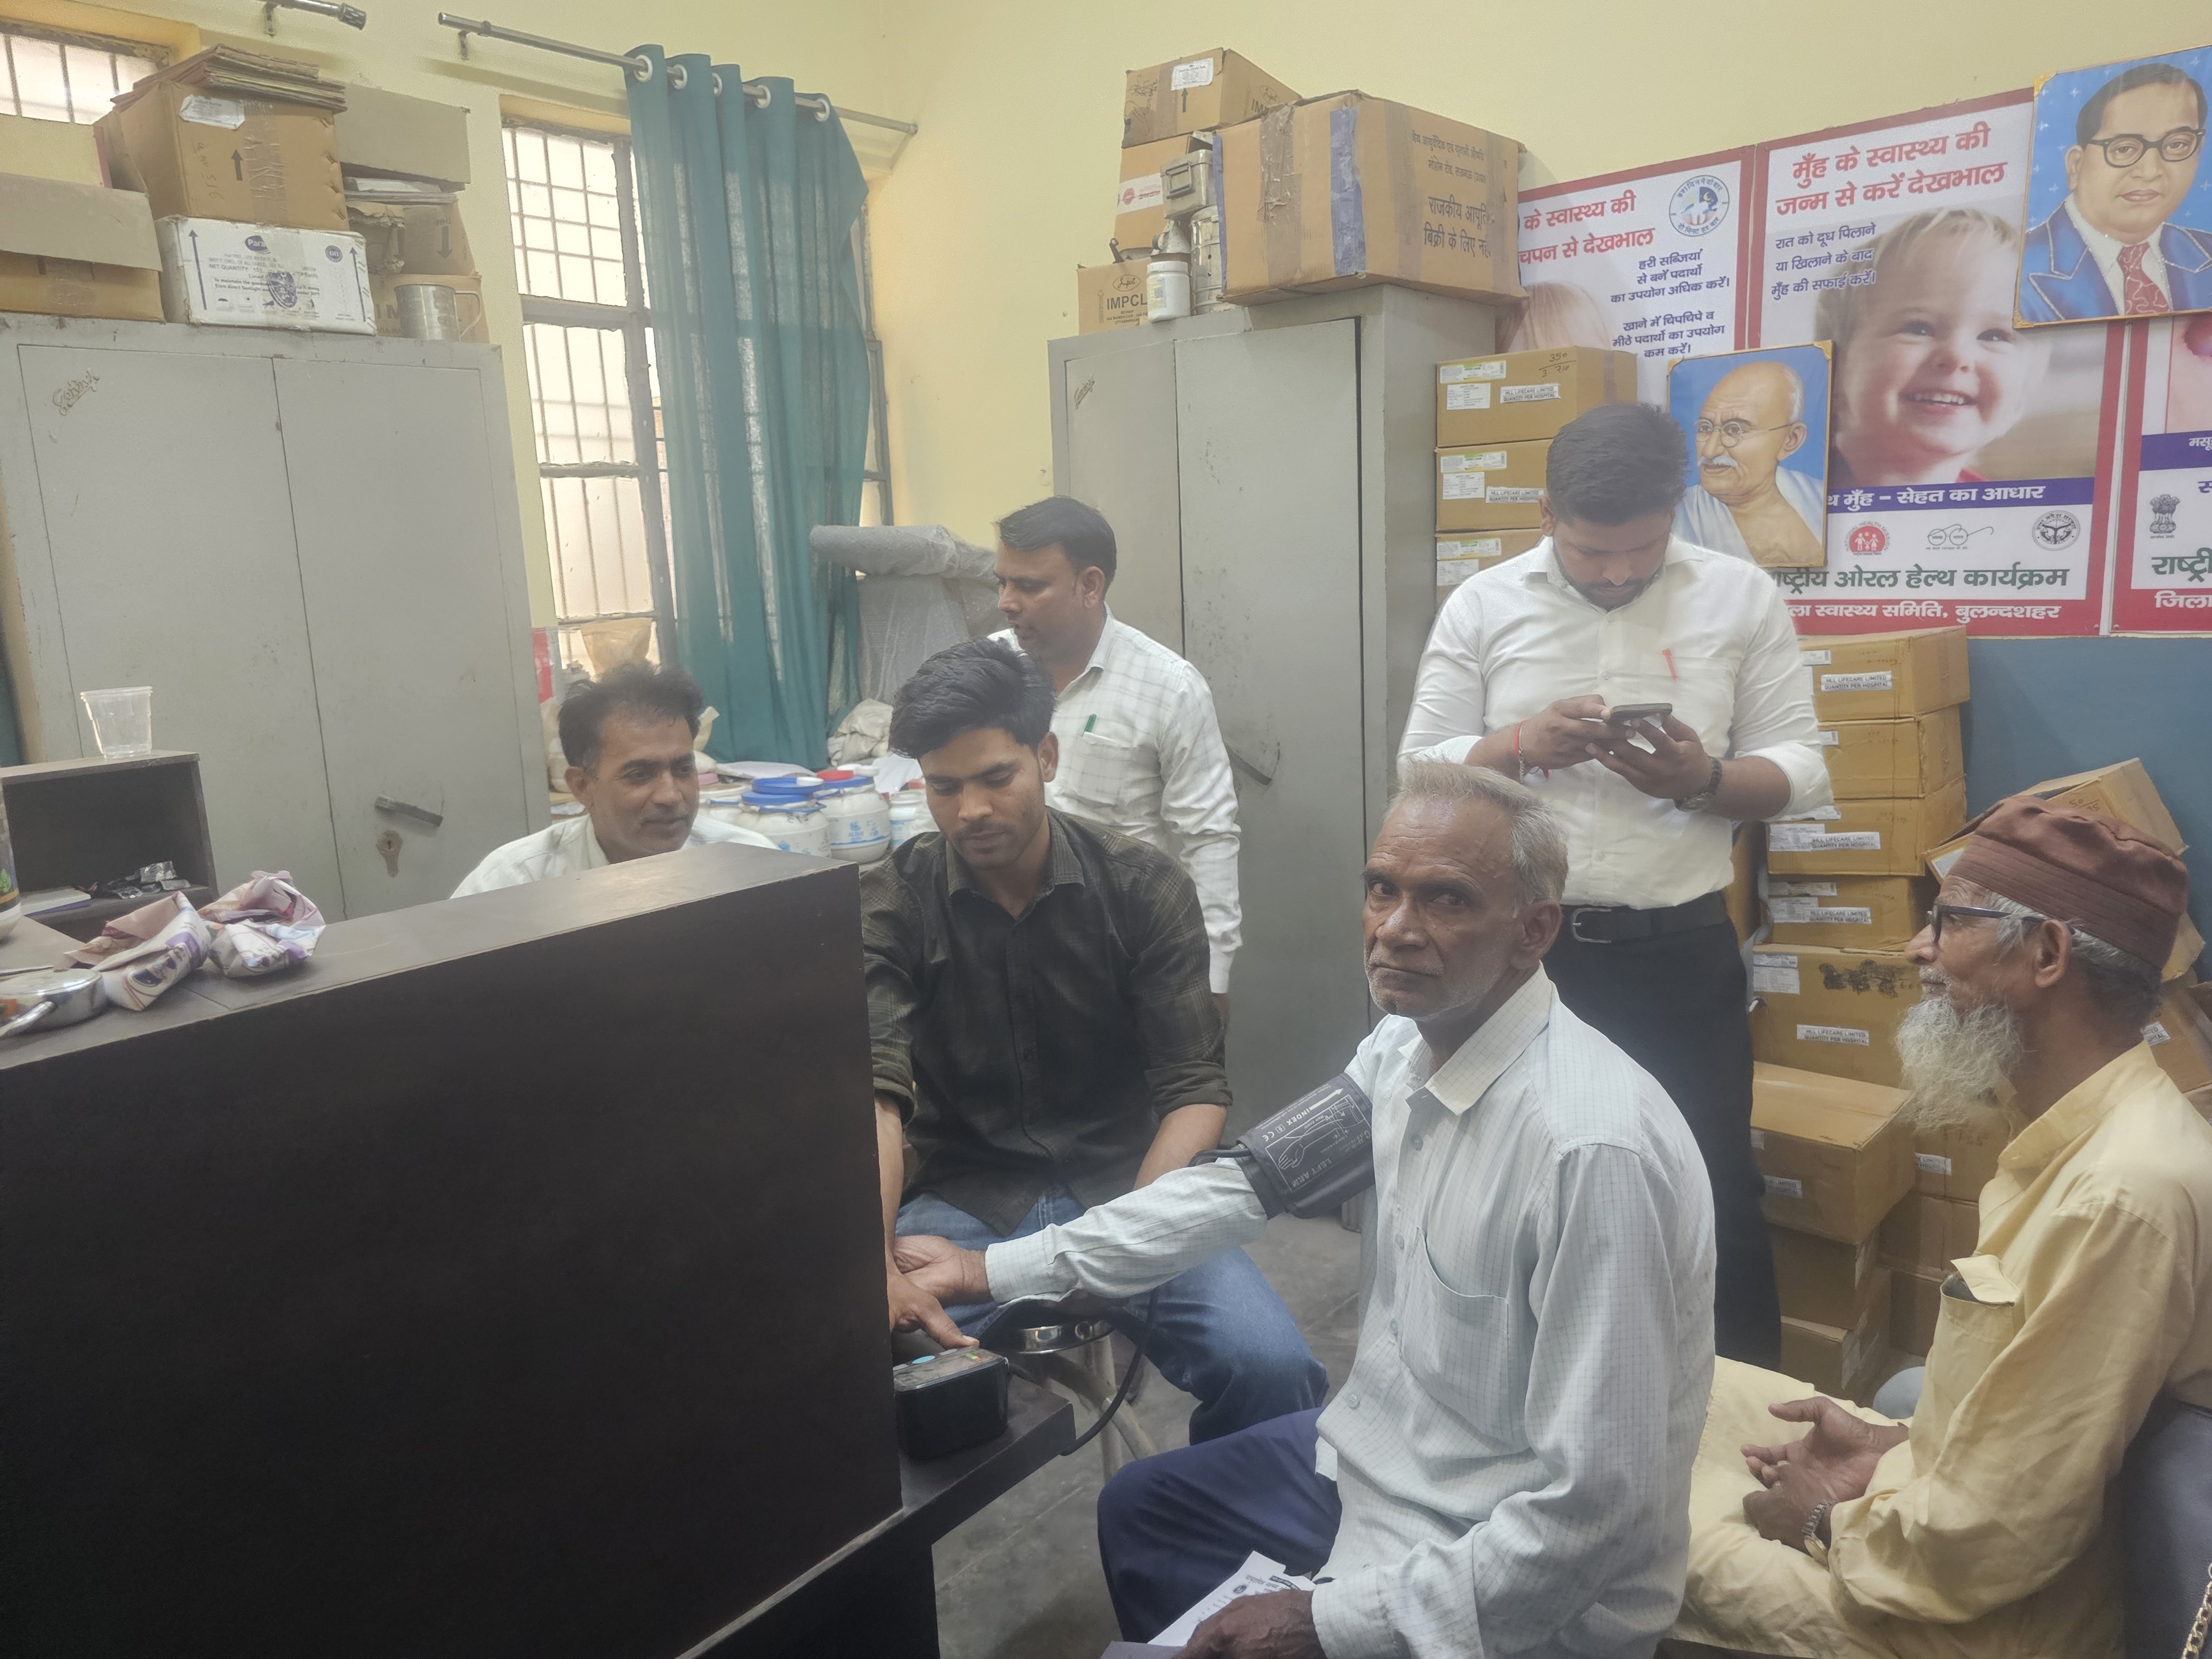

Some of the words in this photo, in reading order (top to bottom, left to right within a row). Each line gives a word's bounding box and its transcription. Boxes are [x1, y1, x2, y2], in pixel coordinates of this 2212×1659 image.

[1793, 153, 1827, 189] मुँह
[1835, 146, 1860, 171] के
[1867, 135, 1949, 167] स्वास्थ्य
[1956, 121, 1991, 150] की
[1776, 191, 1828, 216] जन्म
[1835, 181, 1856, 207] से
[1863, 171, 1905, 201] करें
[1908, 161, 2008, 194] देखभाल
[1428, 194, 1462, 220] राजकीय
[1524, 208, 1541, 230] के
[1546, 201, 1606, 226] स्वास्थ्य
[1611, 190, 1636, 214] की
[248, 239, 267, 248] Para
[1423, 221, 1445, 248] बिक्री
[1448, 226, 1457, 250] के
[1459, 228, 1475, 258] लिए
[1519, 244, 1557, 265] चपन
[1562, 236, 1577, 258] से
[1583, 227, 1655, 254] देखभाल
[1775, 237, 1794, 249] रात
[1797, 231, 1814, 245] को
[1817, 231, 1835, 247] दूध
[1839, 222, 1876, 240] पिलाने
[1639, 256, 1656, 269] हरी
[1775, 261, 1788, 272] या
[1792, 252, 1832, 270] खिलाने
[1835, 250, 1849, 263] के
[1637, 273, 1646, 284] से
[1771, 281, 1790, 300] मुँह
[1793, 278, 1809, 292] की
[1812, 273, 1846, 290] सफाई
[1107, 293, 1147, 310] IMPCL
[1610, 293, 1626, 303] का
[1628, 286, 1665, 301] उपयोग
[1668, 281, 1702, 295] अधिक
[1623, 318, 1647, 331] खाने
[1650, 315, 1662, 327] में
[1663, 310, 1703, 326] चिपचिपे
[1706, 311, 1714, 320] व
[1612, 335, 1632, 347] मीठे
[1668, 331, 1684, 340] का
[1687, 325, 1725, 337] उपयोग
[1644, 348, 1665, 358] कम
[1843, 489, 1875, 512] मुँह
[1897, 487, 1945, 504] सेहत
[1949, 487, 1978, 502] का
[1982, 485, 2046, 501] आधार
[1844, 525, 1859, 551] NATIONAL
[1881, 526, 1890, 552] MISSION
[2151, 547, 2212, 582] राष्ट्री
[1768, 568, 1829, 594] ाष्ट्रीय
[1834, 564, 1901, 588] ओरल
[1906, 564, 1957, 589] हेल्थ
[1964, 561, 2069, 591] कार्यक्रम
[1815, 604, 1879, 618] स्वास्थ्य
[1882, 600, 1948, 618] समिति,
[1955, 604, 2062, 624] बुलन्दशहर
[1285, 1108, 1311, 1126] INDEX
[1309, 1157, 1333, 1175] LEFT
[1290, 1171, 1311, 1188] ARM
